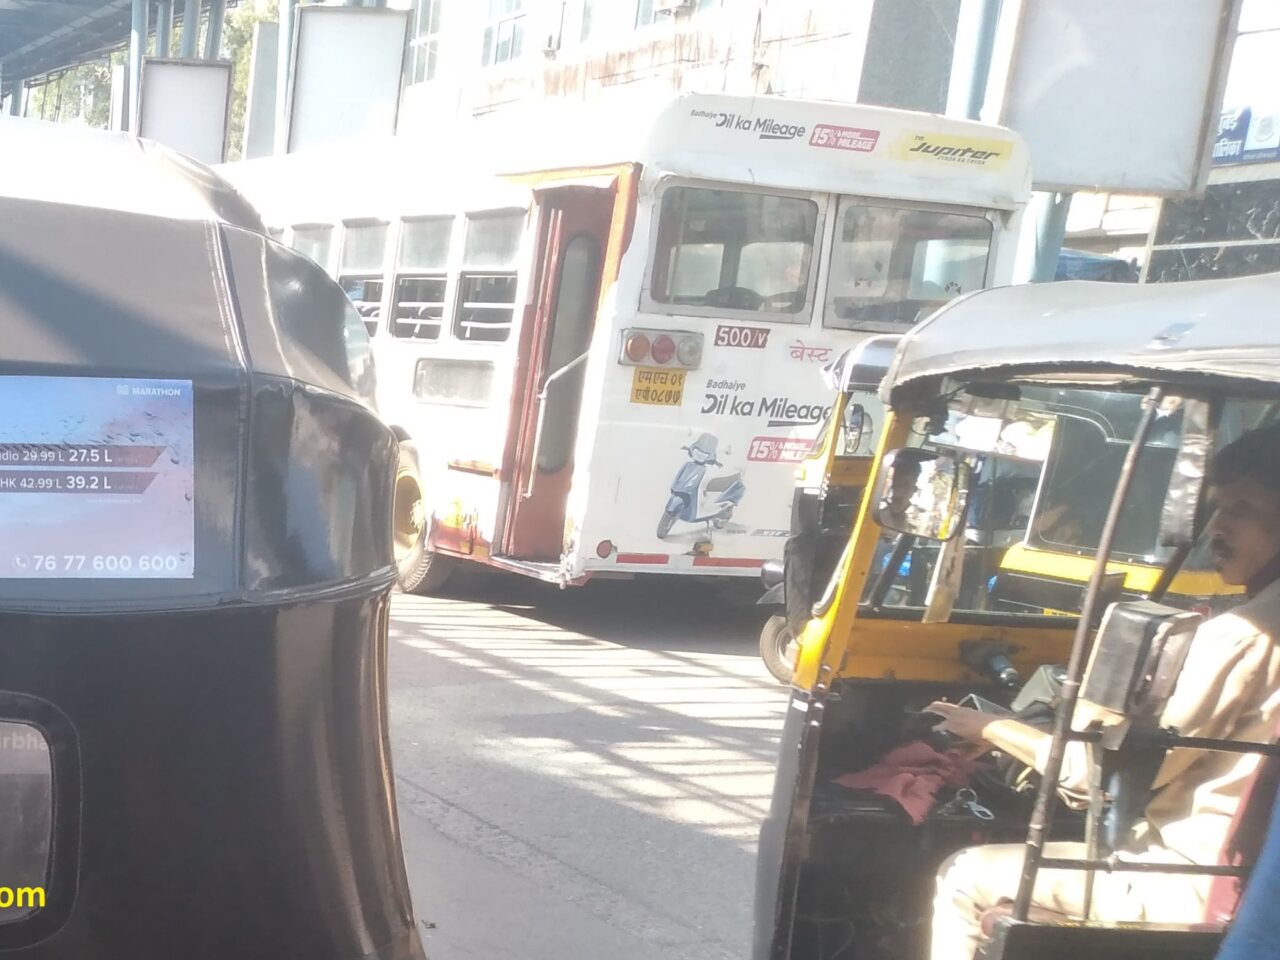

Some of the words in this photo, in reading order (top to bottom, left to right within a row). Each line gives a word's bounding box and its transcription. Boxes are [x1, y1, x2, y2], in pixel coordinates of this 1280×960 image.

[715, 112, 735, 129] Dil
[735, 115, 752, 130] ka
[753, 117, 806, 139] Mileage
[909, 142, 1000, 160] Jupiter
[132, 387, 181, 396] MARATHON
[706, 379, 746, 391] Badhaiye
[701, 393, 729, 415] Dil
[729, 395, 755, 416] ka
[757, 397, 833, 427] Mileage
[23, 450, 56, 462] 29.99
[58, 451, 65, 462] L
[69, 449, 101, 462] 27.5
[104, 449, 113, 463] L
[20, 478, 53, 489] 42.99
[56, 478, 62, 489] L
[66, 476, 99, 489] 39.2
[104, 477, 112, 489] L
[33, 555, 56, 571] 76
[64, 555, 86, 571] 77
[93, 555, 132, 571] 600
[139, 555, 178, 571] 600
